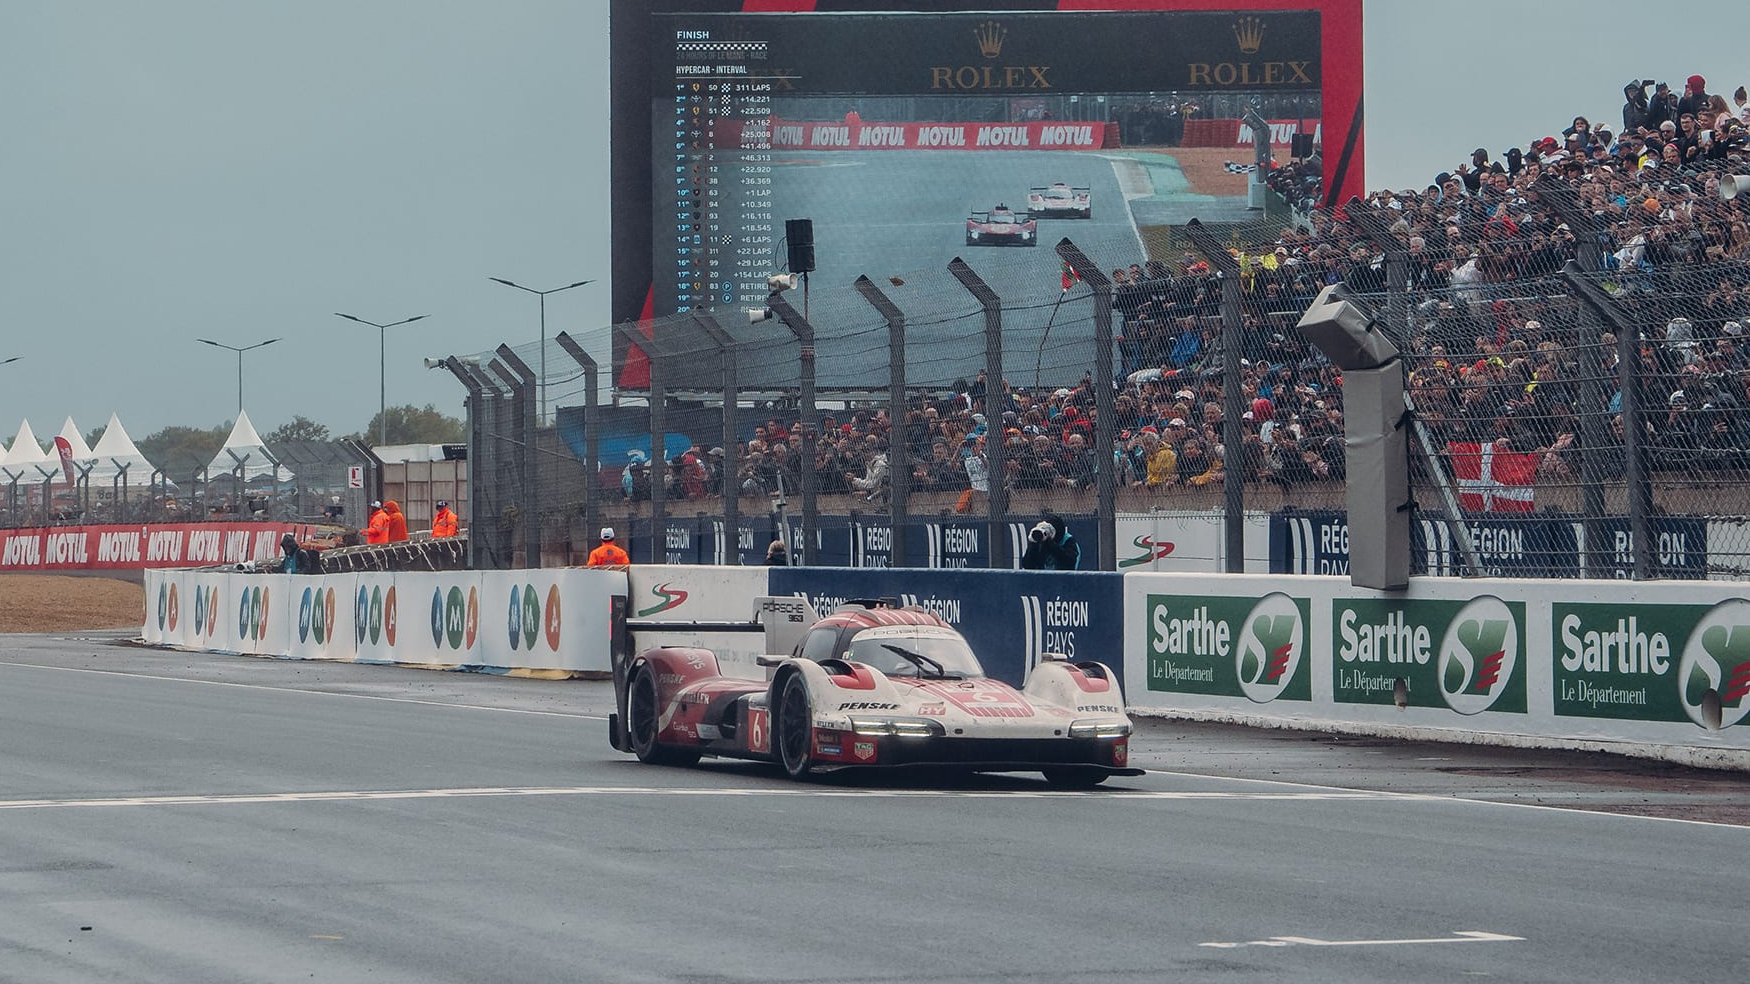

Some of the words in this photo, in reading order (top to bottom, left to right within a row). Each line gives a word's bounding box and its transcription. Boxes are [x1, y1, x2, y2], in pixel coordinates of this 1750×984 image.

[676, 30, 710, 40] FINISH
[676, 65, 710, 74] HYPERCAR
[716, 65, 747, 74] INTERVAL
[930, 66, 1052, 90] ROLEX
[1187, 61, 1312, 86] ROLEX
[812, 126, 850, 147] MOTUL
[859, 126, 904, 146] MOTUL
[917, 126, 965, 147] MOTUL
[976, 126, 1029, 146] MOTUL
[1040, 126, 1093, 145] MOTUL
[1238, 123, 1298, 144] MTU
[2, 535, 41, 565] MOTUL
[45, 532, 88, 563] MOTUL
[97, 532, 141, 562] MOTUL
[187, 530, 220, 561] MOTUL
[866, 523, 891, 552] RÉGIO
[945, 524, 978, 554] RÉGION
[1320, 519, 1349, 554] RÉG
[1469, 521, 1523, 560] ÉGION
[762, 602, 804, 614] PORSCHE
[788, 615, 804, 623] 963
[1046, 596, 1089, 627] RÉGION
[1152, 603, 1231, 657] Sarthe
[1339, 608, 1431, 665] Sarthe
[1046, 631, 1075, 659] PAYS
[1561, 613, 1671, 676] Sarthe
[1153, 659, 1164, 679] Le
[1165, 661, 1213, 683] Département
[1340, 669, 1352, 689] Le
[838, 702, 900, 712] PENSKE
[1562, 679, 1575, 702] Le
[1578, 680, 1647, 709] Département
[1077, 705, 1119, 714] PENSKE
[753, 712, 762, 748] 6
